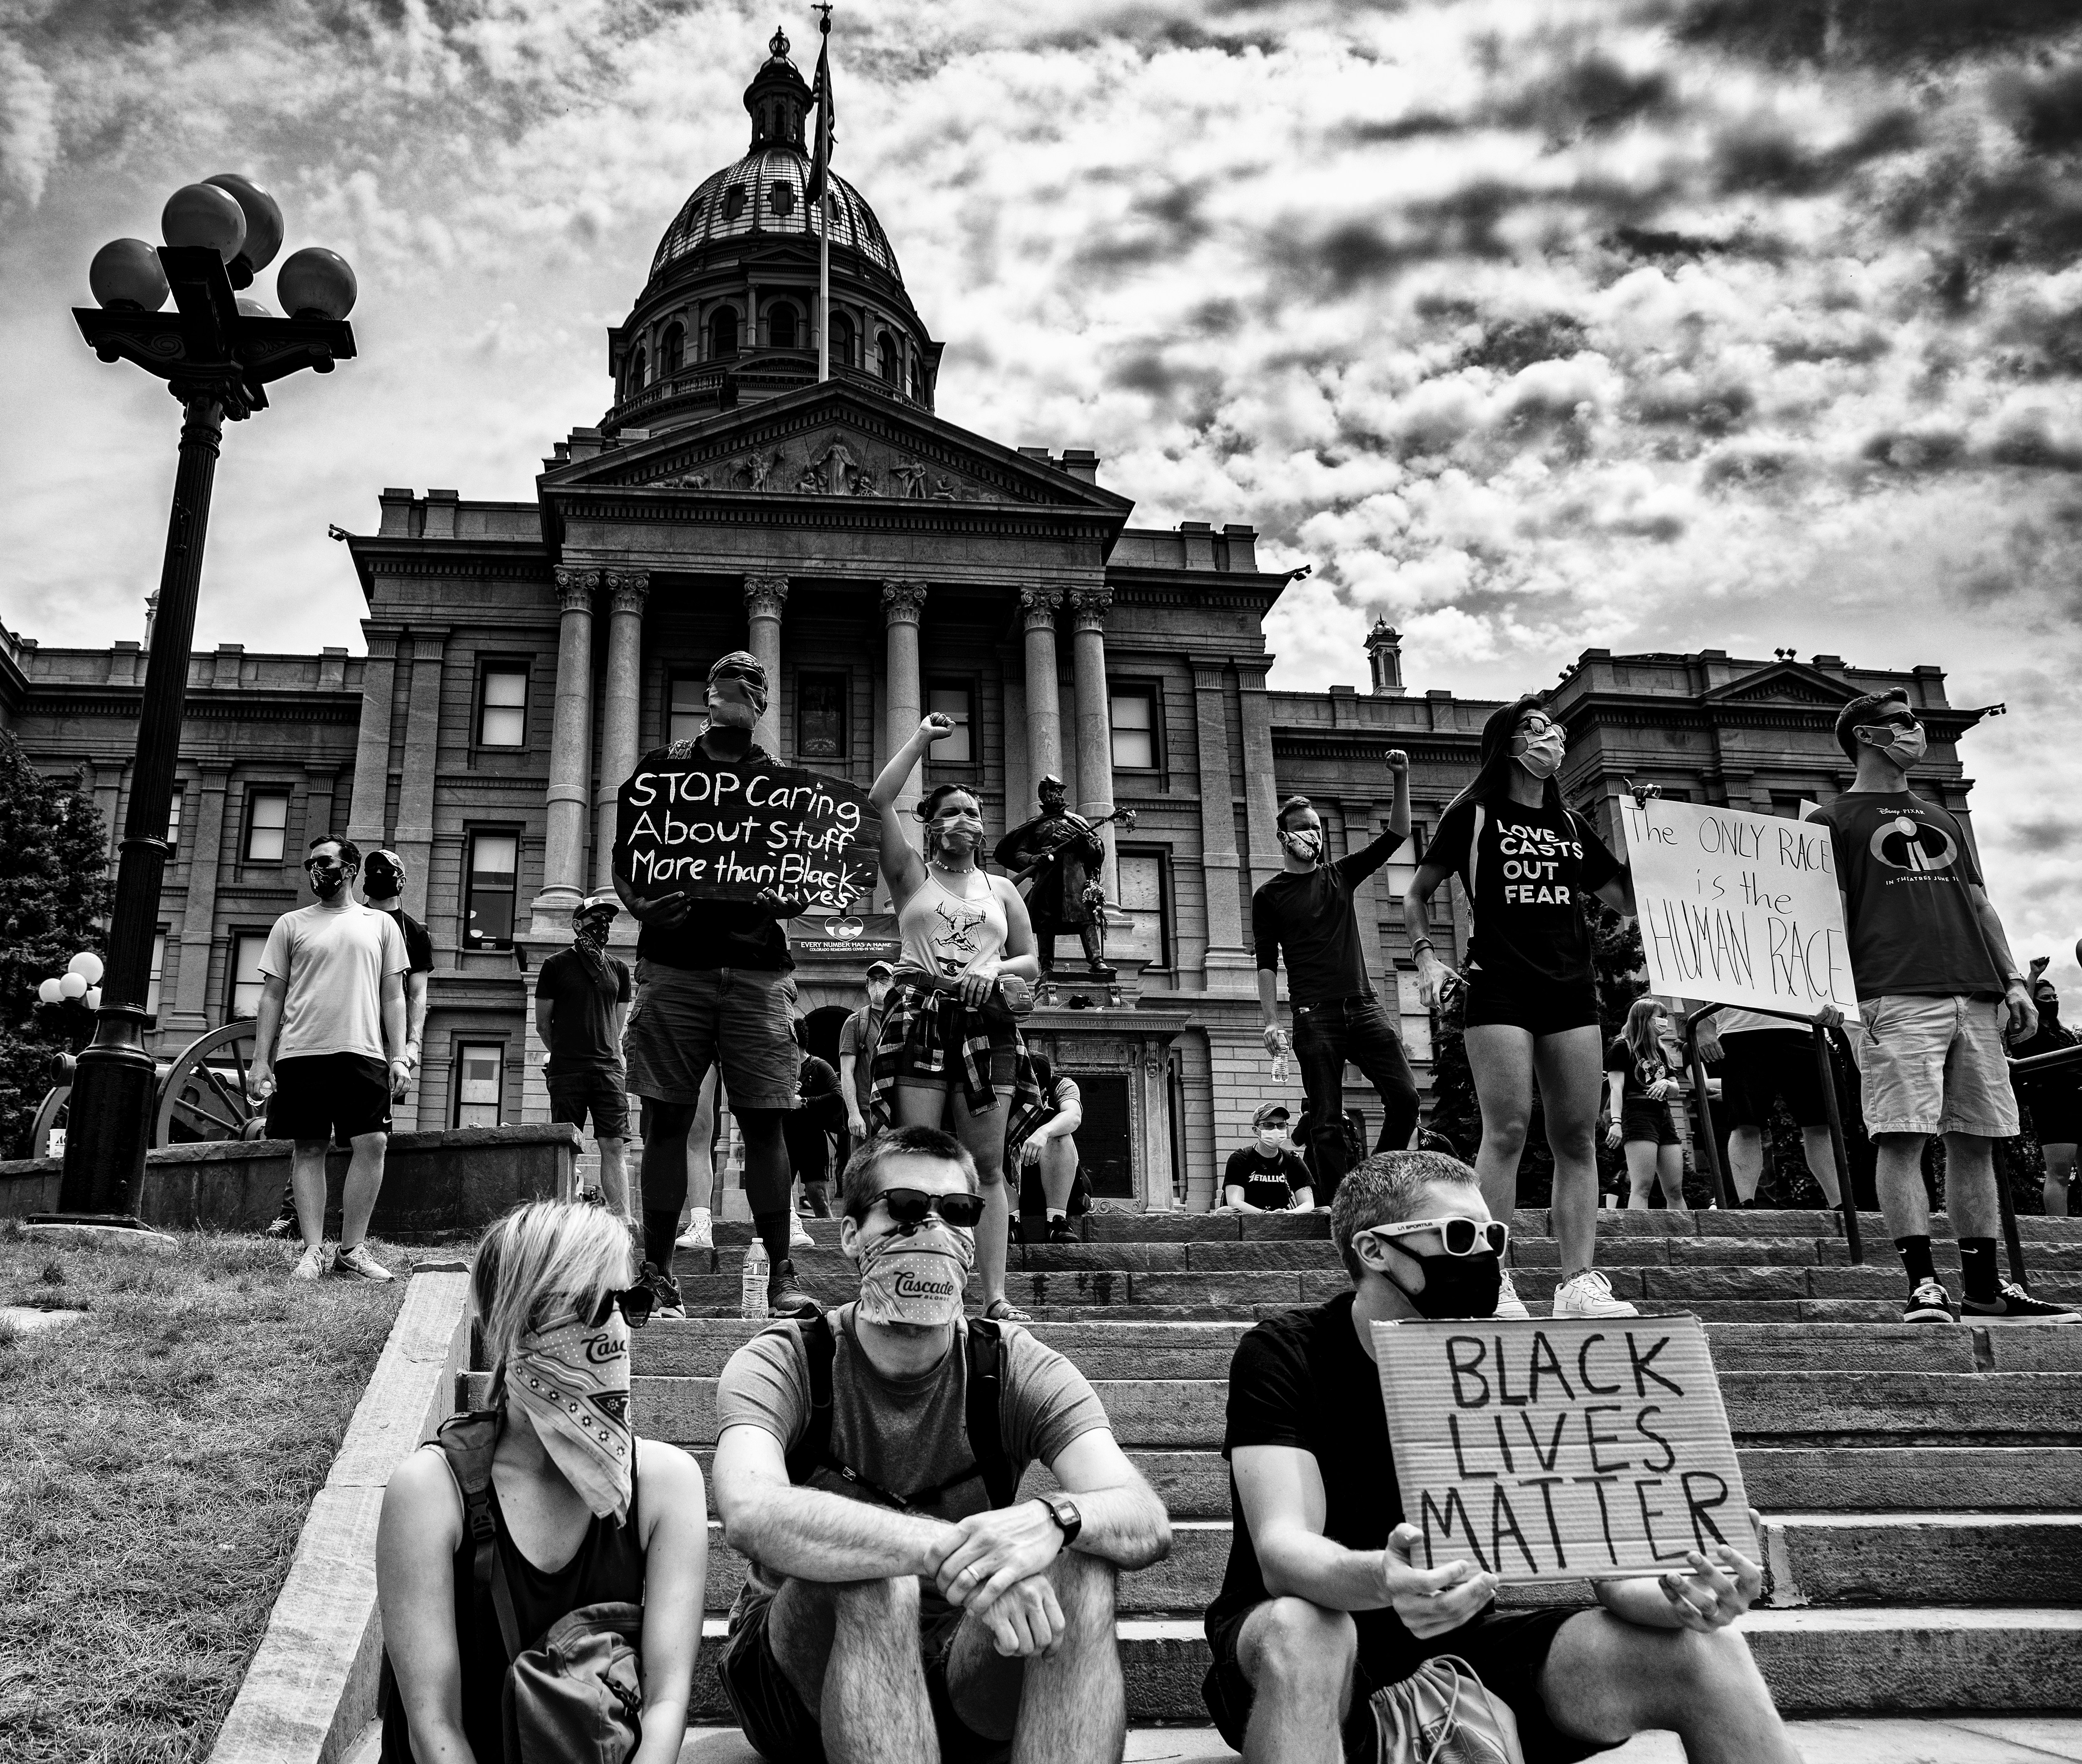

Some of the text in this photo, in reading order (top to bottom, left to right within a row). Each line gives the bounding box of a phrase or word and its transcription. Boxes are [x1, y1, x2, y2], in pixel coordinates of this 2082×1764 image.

[629, 772, 860, 832] STOP Caring
[628, 810, 855, 854] About Stuff
[1497, 819, 1559, 842] LOVE
[1500, 837, 1583, 859] CASTS
[1625, 806, 1832, 873] The ONLY RACE
[632, 849, 861, 895] More than Black
[1503, 861, 1559, 880] OUT
[1697, 869, 1793, 914] is the
[778, 883, 854, 908] Lives
[1505, 885, 1570, 904] FEAR
[1647, 898, 1853, 1006] HUMAN RACE
[894, 1271, 954, 1298] Cascade
[1446, 1331, 1684, 1408] BLACK
[1448, 1405, 1676, 1480] LIVES
[1420, 1471, 1730, 1574] MATTER
